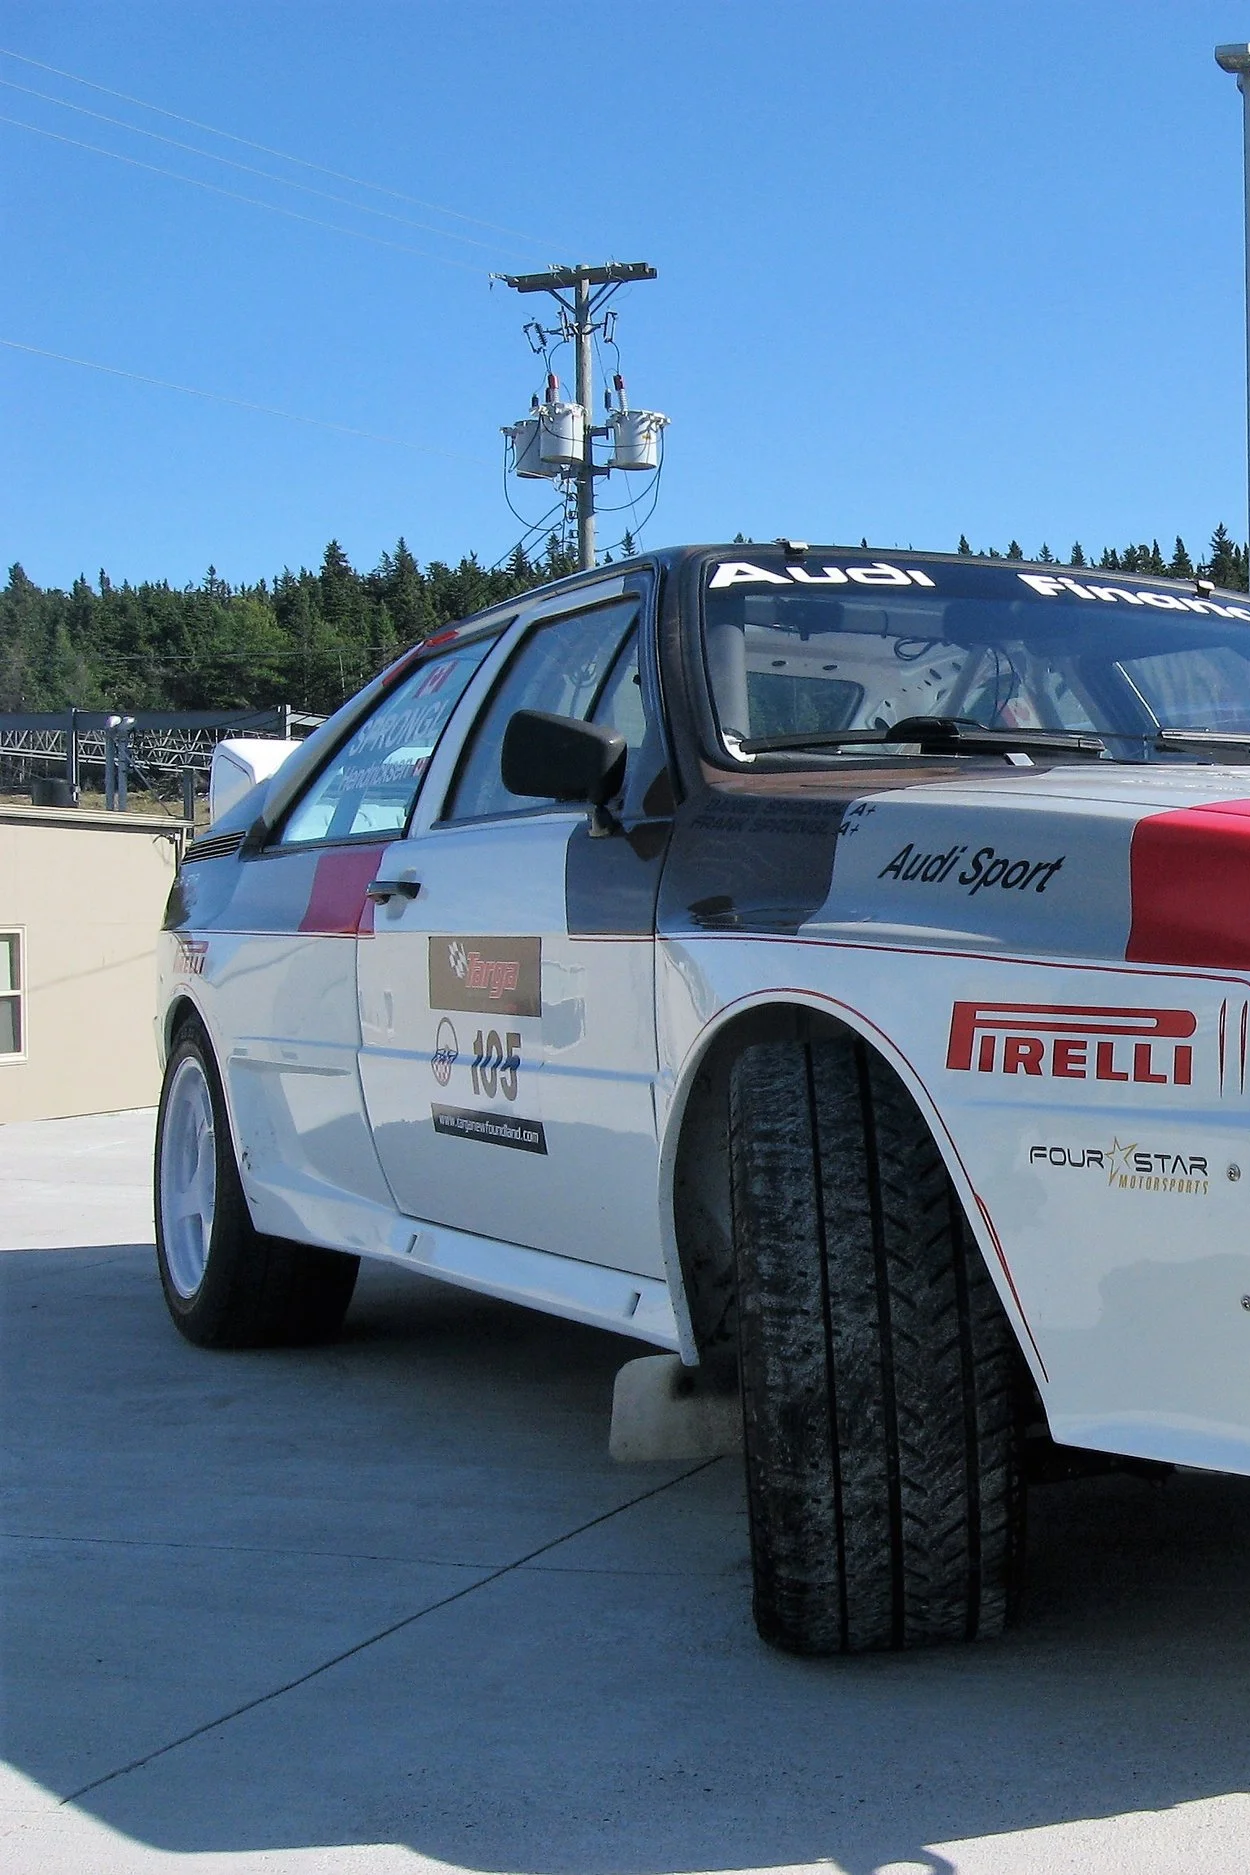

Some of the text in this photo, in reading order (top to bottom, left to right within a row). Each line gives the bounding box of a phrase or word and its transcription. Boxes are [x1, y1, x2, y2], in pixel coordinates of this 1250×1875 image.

[709, 562, 936, 589] Audi
[849, 803, 877, 817] A+
[832, 821, 860, 837] A+
[878, 843, 1067, 896] Audi Sport
[465, 952, 520, 999] Targa
[945, 1001, 1197, 1085] PIRELLI
[471, 1030, 521, 1101] 105
[1030, 1146, 1208, 1176] FOUR STAR
[1117, 1174, 1209, 1195] MOTORSPORTS
